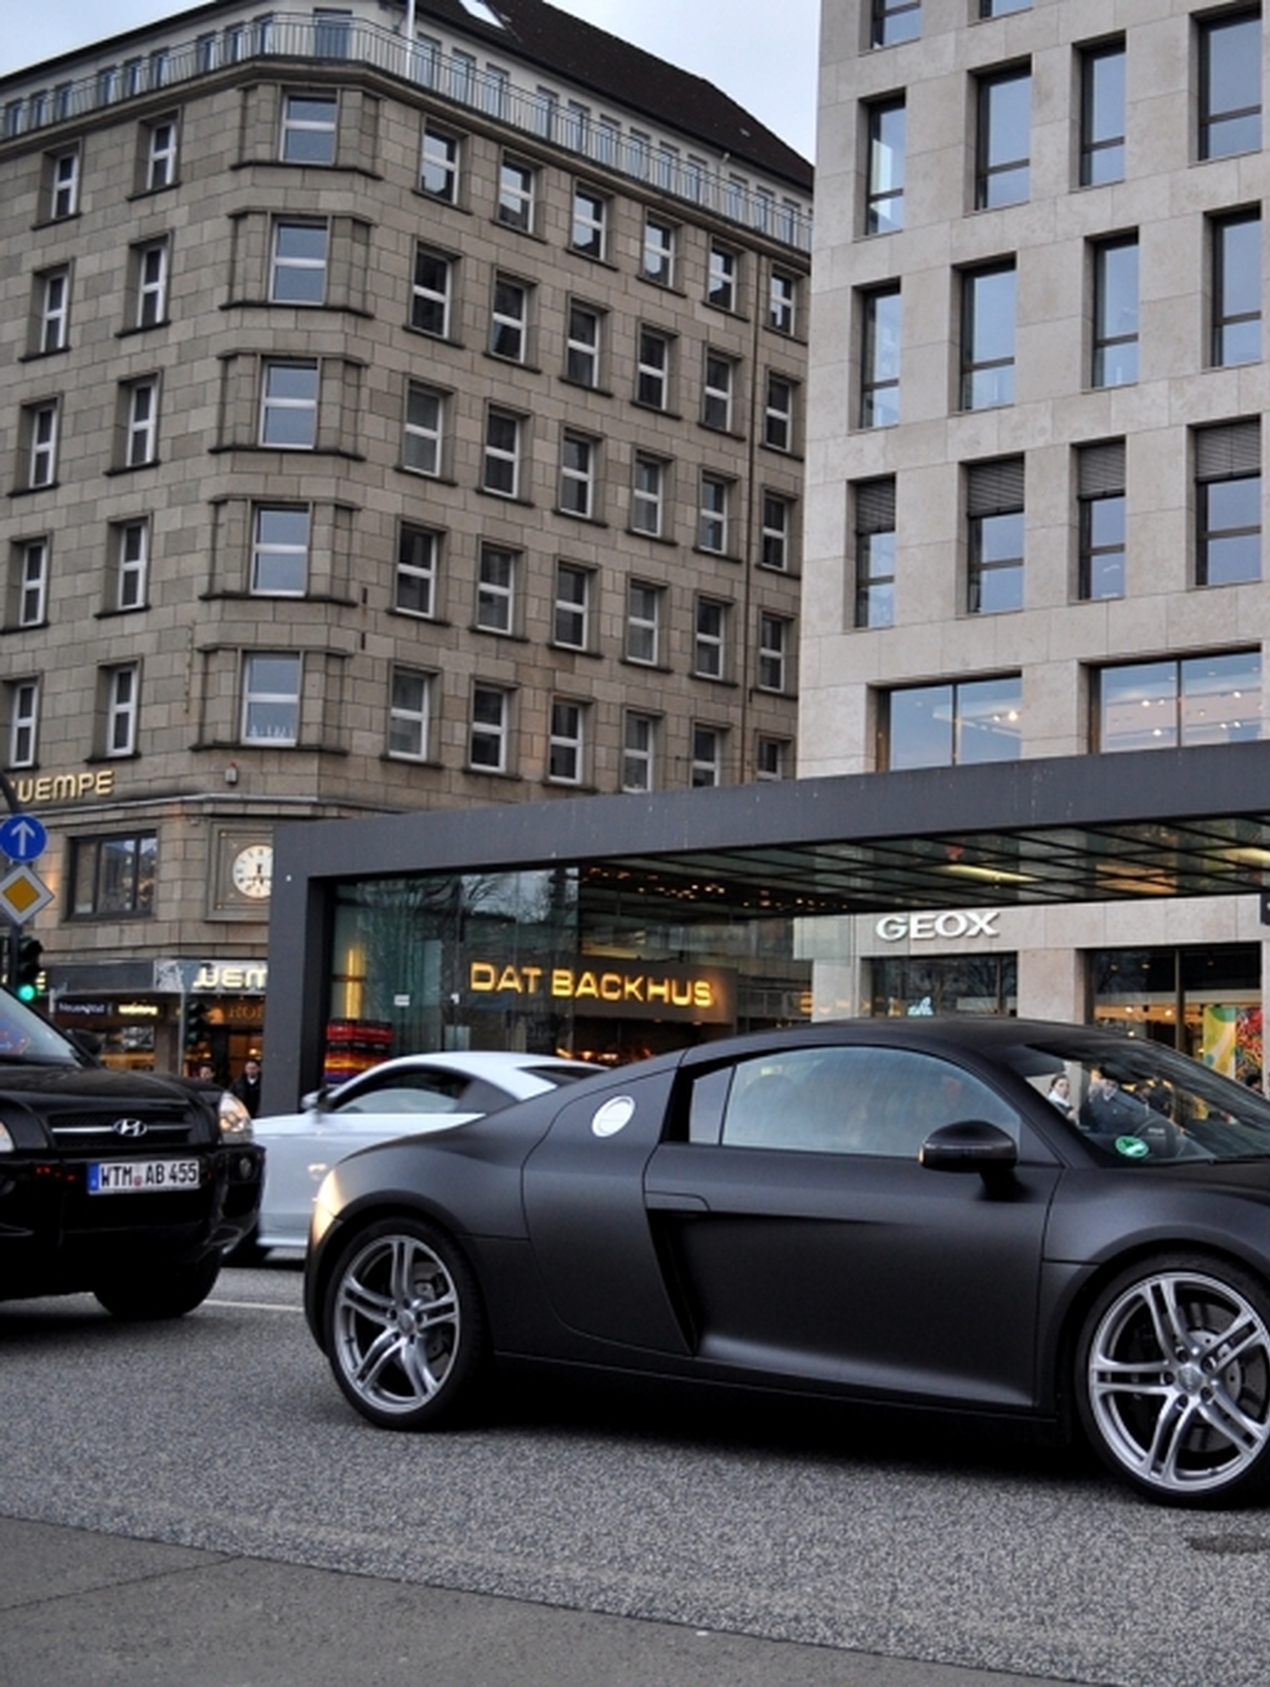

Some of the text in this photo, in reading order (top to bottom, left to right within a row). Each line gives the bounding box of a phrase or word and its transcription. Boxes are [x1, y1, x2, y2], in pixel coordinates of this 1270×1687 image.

[875, 911, 1000, 941] GEOX
[469, 961, 714, 1008] DAT BACKHUS
[101, 1162, 198, 1187] WTM AB 455
